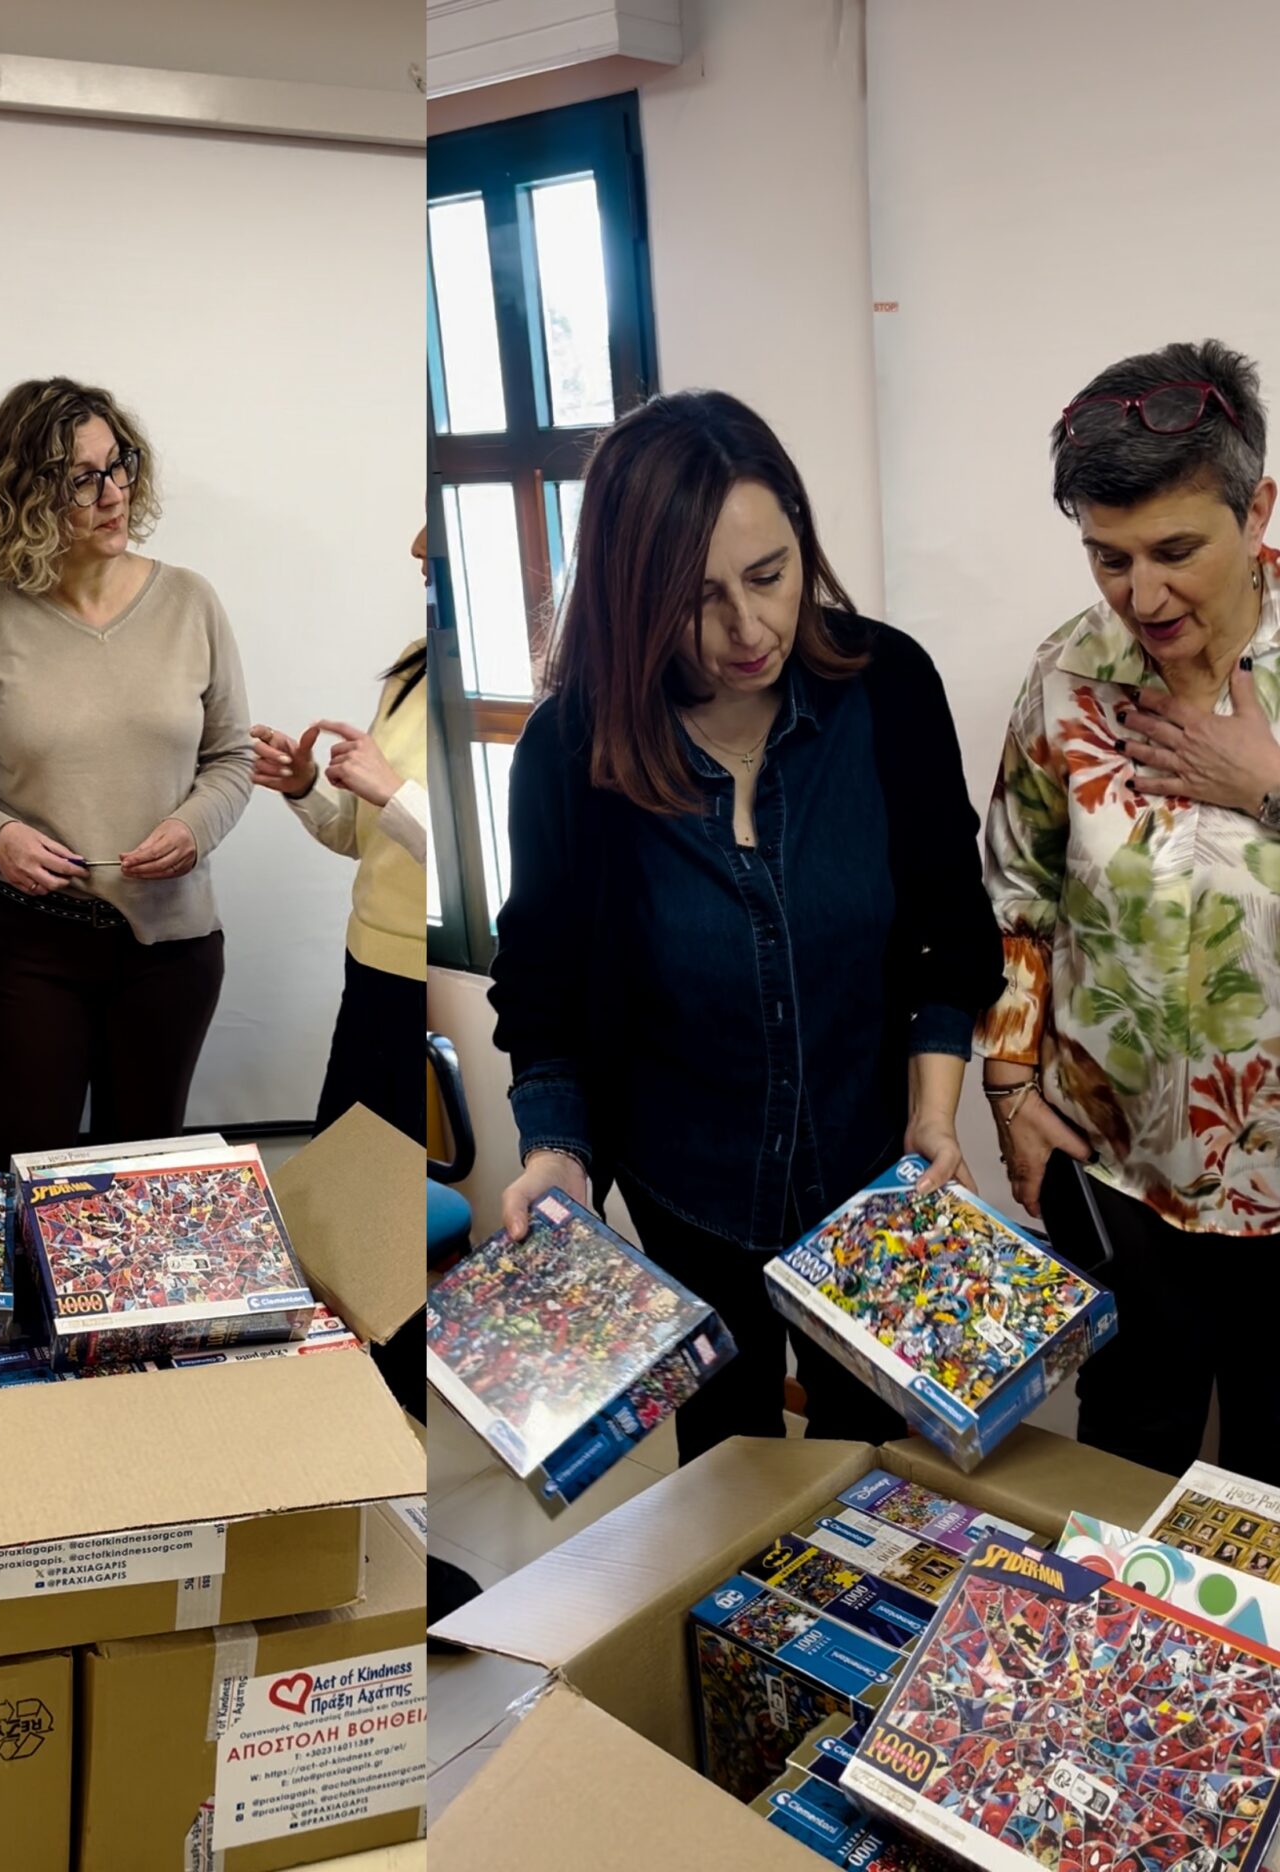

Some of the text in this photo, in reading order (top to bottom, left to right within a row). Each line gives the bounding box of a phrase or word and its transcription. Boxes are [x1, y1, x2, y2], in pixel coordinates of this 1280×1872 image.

[899, 1160, 924, 1183] DC
[784, 1245, 830, 1283] 1000
[55, 1294, 104, 1316] 1000
[261, 1294, 308, 1307] Clementoni
[923, 1386, 967, 1423] Clementoni
[848, 1477, 892, 1500] Disney
[933, 1512, 960, 1531] 1000
[830, 1523, 871, 1544] Clementoni
[68, 1541, 194, 1562] @actofkindnessorgcom
[47, 1560, 128, 1577] @PRAXIAGAPIS
[47, 1571, 128, 1588] @PRAXIAGAPIS
[971, 1543, 1066, 1594] SPIDER-MAN
[718, 1589, 744, 1609] DC
[839, 1584, 869, 1607] 1000
[877, 1604, 922, 1631] Clementoni
[792, 1629, 823, 1652] 1000
[830, 1651, 878, 1678] Clementoni
[313, 1661, 413, 1692] Act of Kindness
[217, 1677, 232, 1717] Kindness
[232, 1675, 248, 1715] Αγάπης
[311, 1682, 413, 1716] Πράξη Αγάπης
[226, 1726, 339, 1764] ΑΠΟΣΤΟΛΗ
[304, 1737, 375, 1759] +302316011389
[864, 1726, 931, 1783] 1000
[291, 1760, 384, 1786] info@praxiagapis.gr
[300, 1806, 368, 1828] @PRAXIAGAPIS
[301, 1796, 369, 1818] @PRAXIAGAPIS
[787, 1801, 840, 1835] Clementoni
[847, 1835, 884, 1867] 1000
